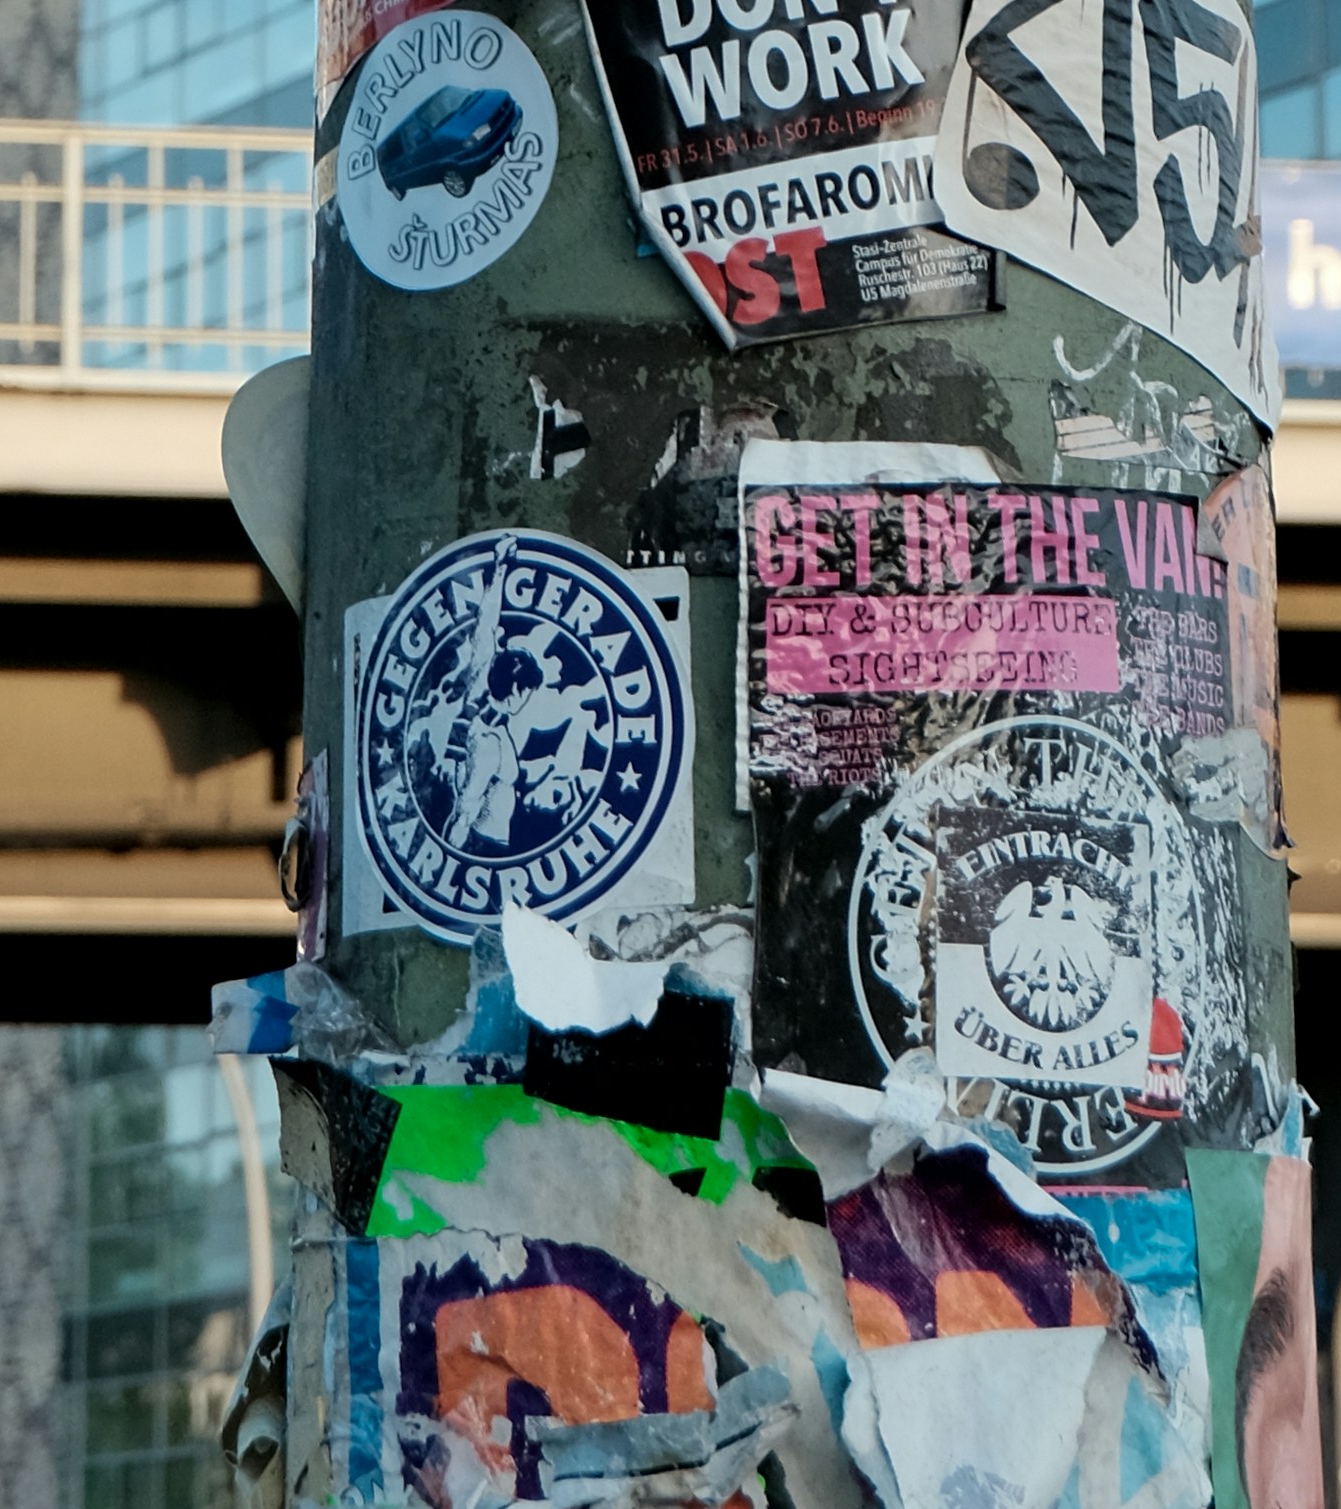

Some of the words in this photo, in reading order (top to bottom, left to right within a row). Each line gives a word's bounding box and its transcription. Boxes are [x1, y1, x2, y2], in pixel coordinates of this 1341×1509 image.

[658, 8, 926, 128] WORK
[348, 19, 503, 181] BERLYNO
[637, 153, 658, 173] FR
[716, 139, 738, 157] SA
[813, 116, 846, 136] 7.6.
[852, 234, 927, 259] Stasi-Zentrale
[855, 254, 901, 274] Campus
[917, 263, 937, 277] 103
[939, 258, 969, 277] (Haus
[970, 255, 988, 272] 22)
[755, 493, 881, 588] GET
[903, 493, 971, 585] IN
[988, 493, 1107, 586] THE
[770, 603, 836, 637] DIY
[850, 602, 877, 635] &
[891, 600, 1114, 636] SUBCULTURE
[828, 649, 1079, 686] SIGHTSEEING
[376, 775, 635, 908] KARLSRUHE
[954, 1005, 1044, 1070] ÜBER
[1052, 1020, 1138, 1071] ALLES
